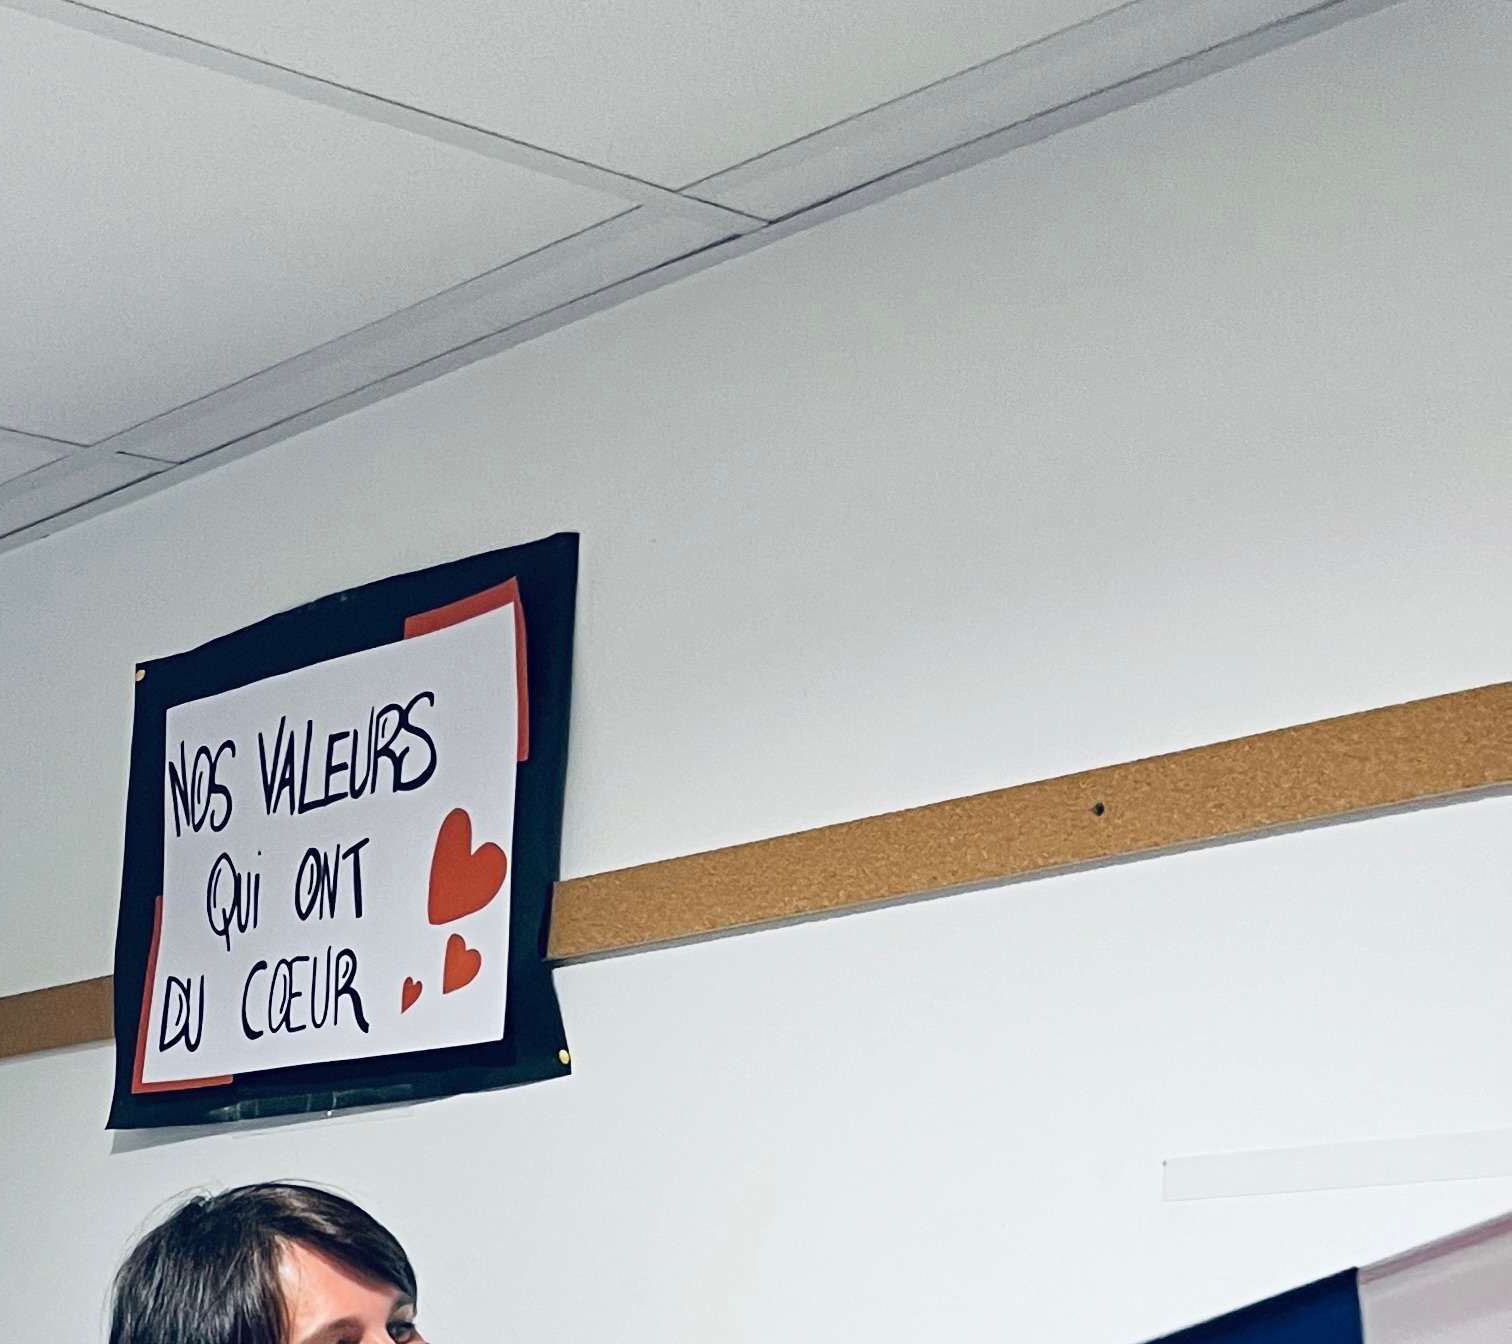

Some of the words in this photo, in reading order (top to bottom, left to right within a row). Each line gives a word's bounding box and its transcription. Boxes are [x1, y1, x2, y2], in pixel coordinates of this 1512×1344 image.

[168, 739, 236, 838] NOS
[257, 691, 437, 816] VALEURS
[294, 837, 371, 922] ONT
[158, 974, 206, 1053] DU
